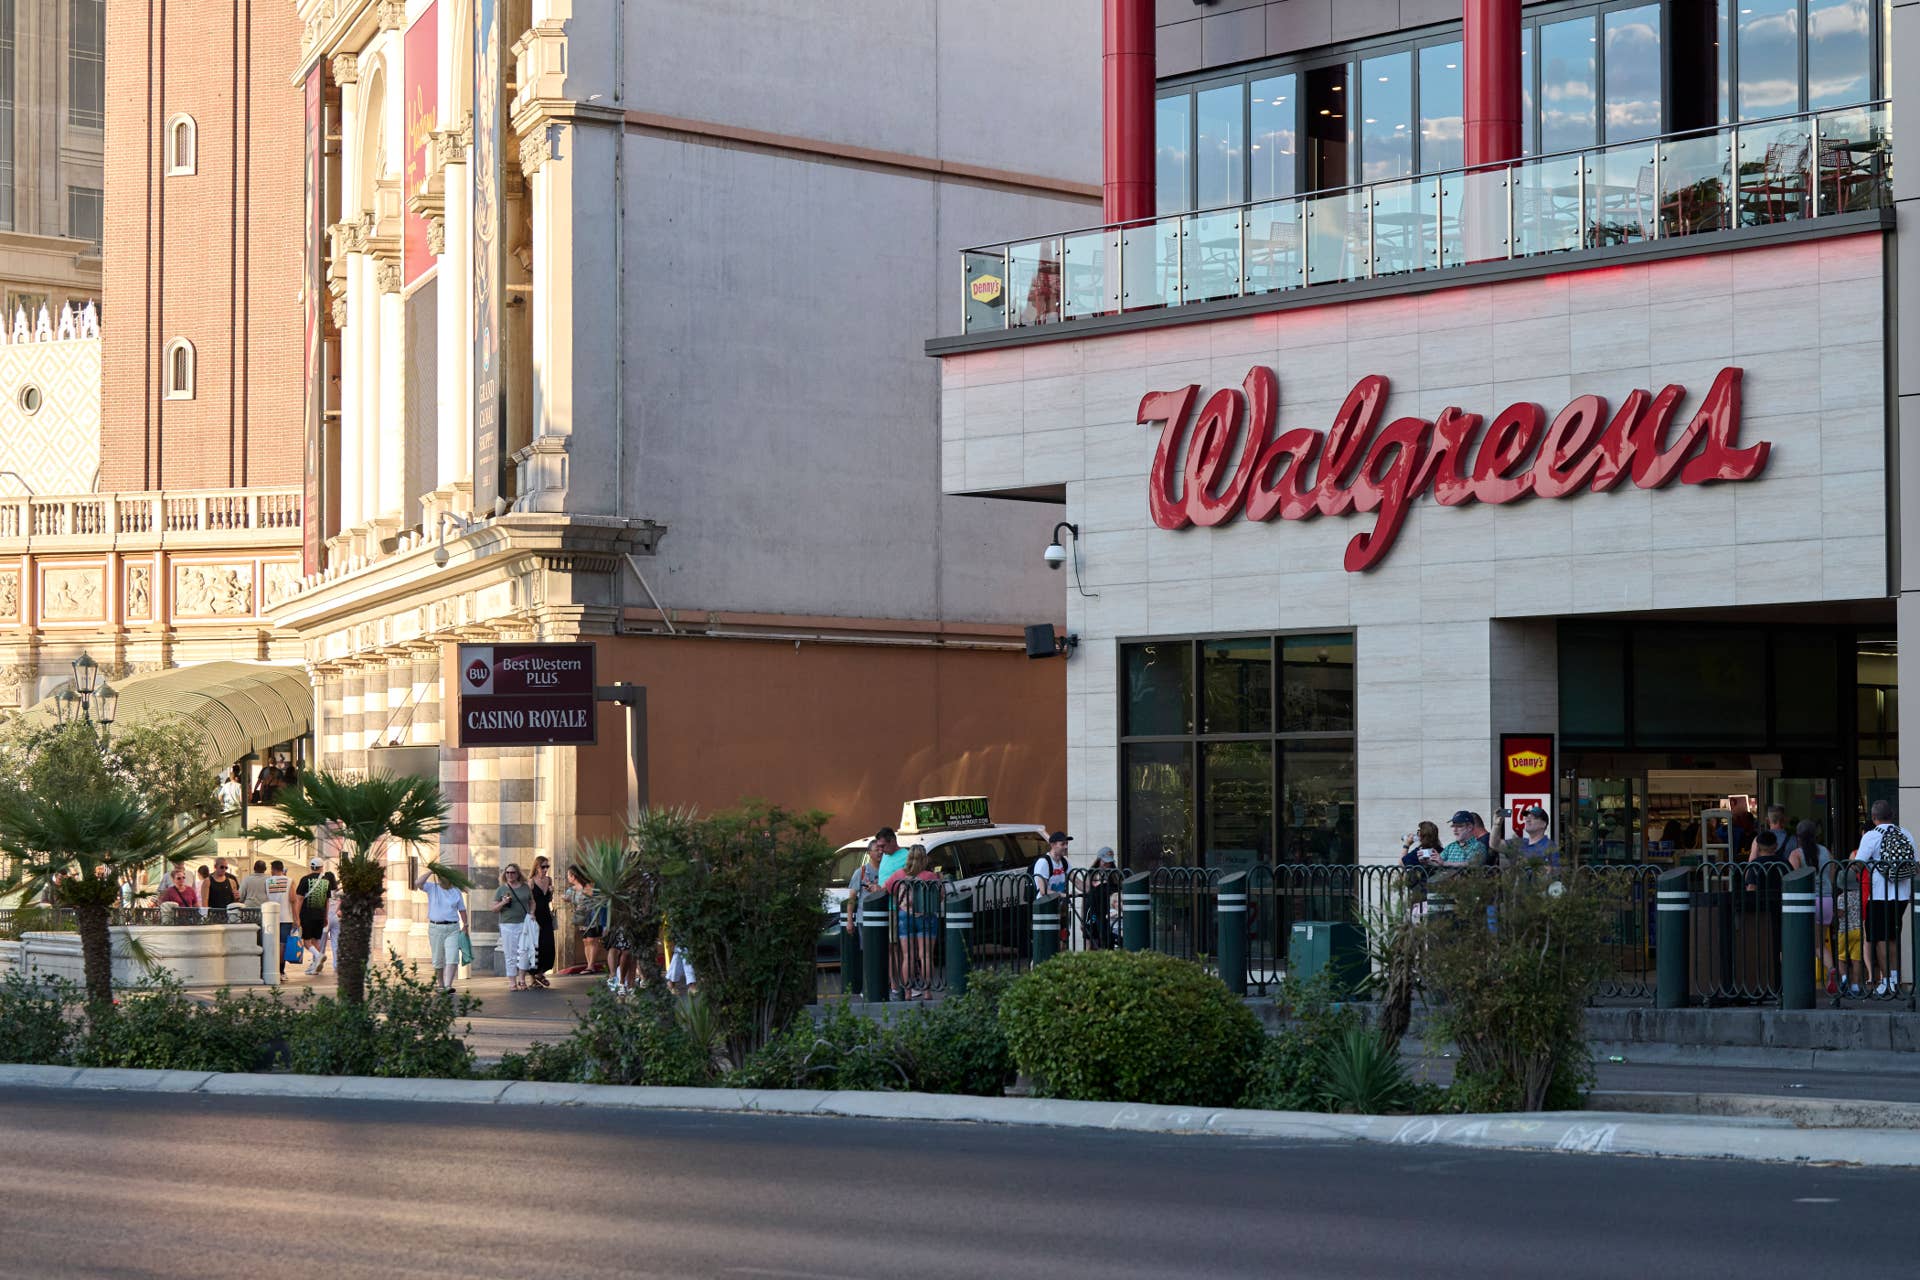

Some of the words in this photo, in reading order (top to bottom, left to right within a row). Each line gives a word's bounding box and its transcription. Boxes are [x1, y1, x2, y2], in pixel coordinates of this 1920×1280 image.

[972, 280, 1000, 296] Denny's
[1138, 366, 1770, 572] Walgreens
[503, 658, 529, 671] Best
[532, 658, 581, 671] Western
[469, 668, 488, 680] BW
[527, 672, 558, 684] PLUS
[468, 711, 524, 729] CASINO
[528, 710, 587, 728] ROYALE
[1512, 757, 1544, 769] Denny's
